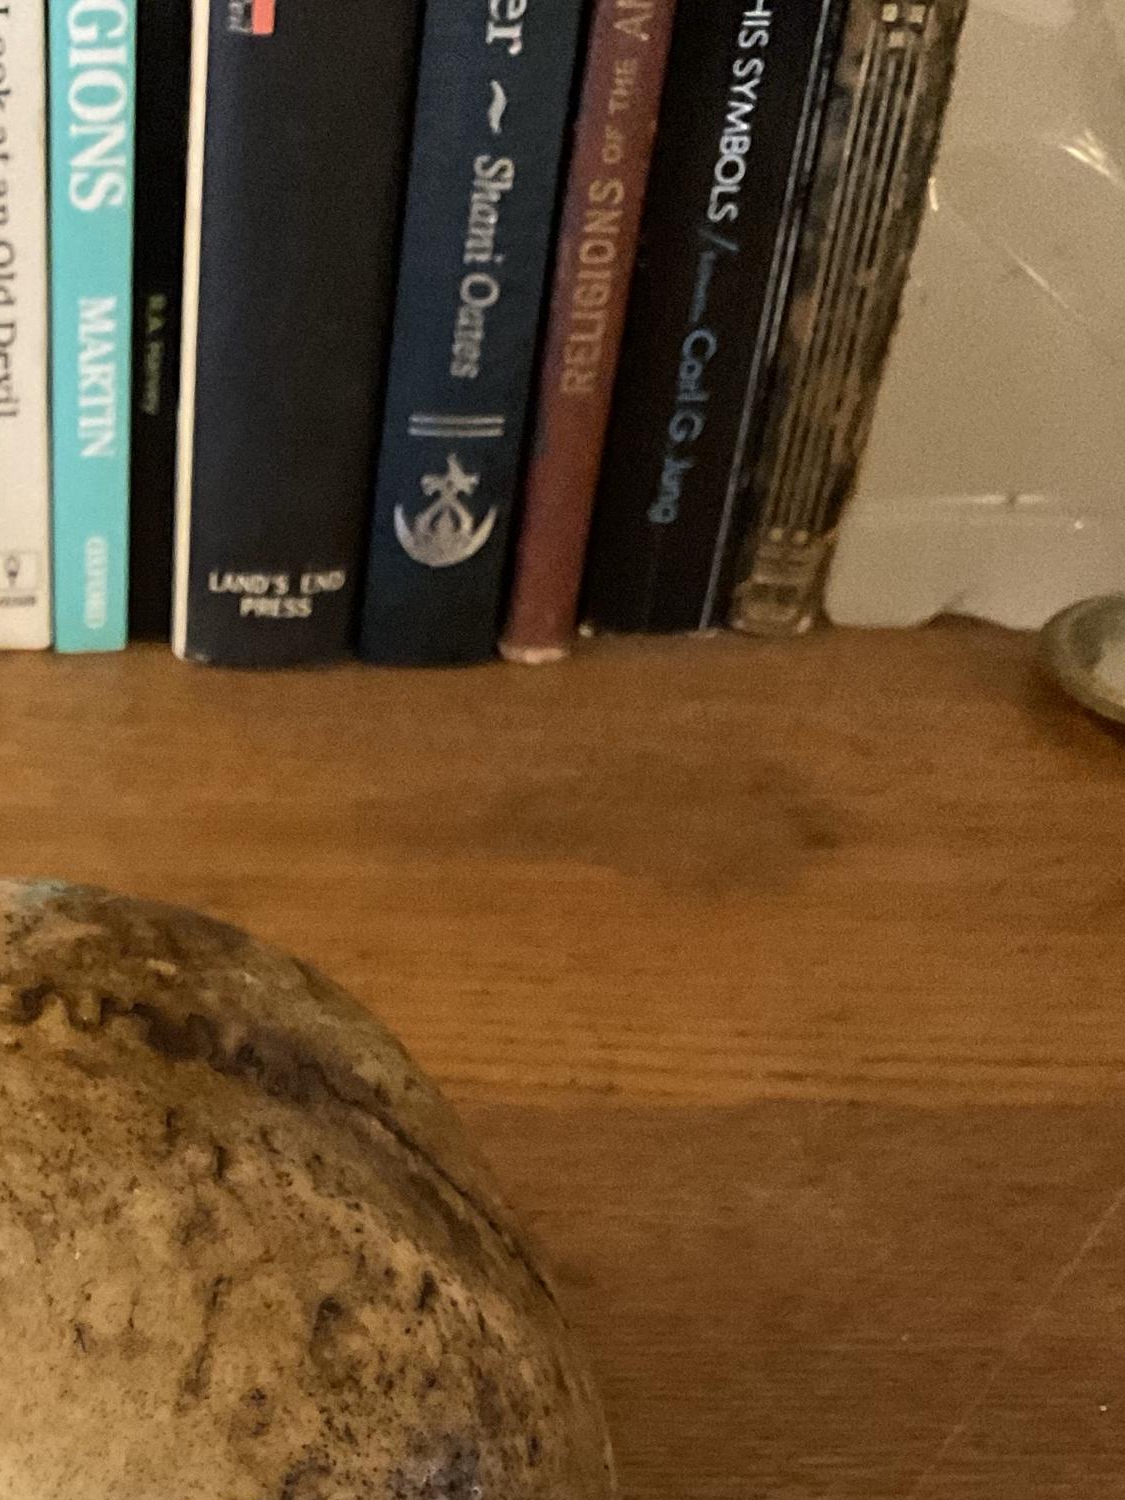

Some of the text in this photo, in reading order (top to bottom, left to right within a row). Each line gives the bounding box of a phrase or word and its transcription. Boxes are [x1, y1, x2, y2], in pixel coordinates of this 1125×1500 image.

[608, 58, 638, 114] THE
[707, 55, 764, 224] SYMBOLS
[602, 125, 623, 164] OF
[67, 0, 128, 459] GIONS MARTIN
[561, 177, 624, 395] RELIGIONS
[299, 569, 346, 594] END
